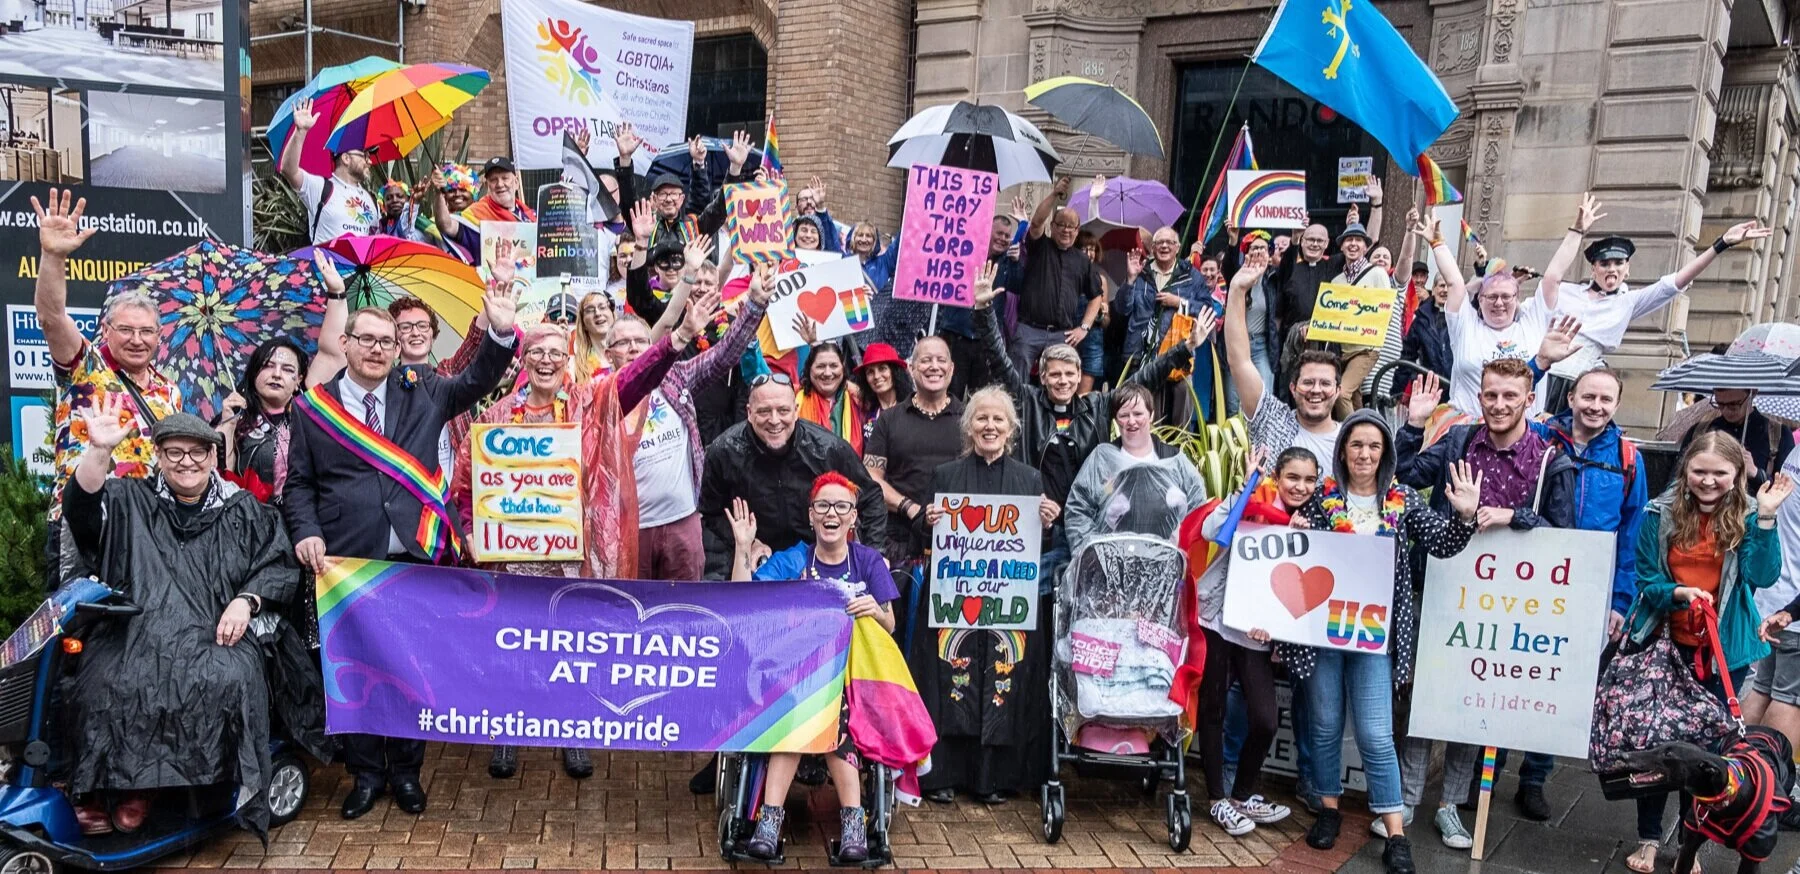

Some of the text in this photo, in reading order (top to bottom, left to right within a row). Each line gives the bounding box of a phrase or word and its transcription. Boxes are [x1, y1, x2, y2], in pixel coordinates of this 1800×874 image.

[622, 31, 636, 41] Safe
[638, 36, 657, 45] sacred
[616, 49, 674, 71] LGBTQIA+
[616, 70, 669, 94] Christians
[1193, 97, 1338, 131] RANDO
[590, 118, 616, 139] TAB
[912, 165, 992, 195] THIS IS
[924, 191, 982, 217] A GAY
[1255, 205, 1304, 220] KINDNESS
[739, 220, 784, 244] WINS
[929, 213, 967, 235] THE
[537, 245, 597, 259] Rainbow
[922, 233, 974, 257] LORD
[18, 255, 40, 279] AL
[926, 258, 965, 280] HAS
[913, 278, 968, 301] MADE
[838, 287, 869, 331] U
[1319, 290, 1349, 310] Come
[1353, 302, 1379, 316] you
[1360, 327, 1378, 336] you
[14, 350, 52, 367] 015
[484, 428, 554, 457] Come
[658, 427, 681, 444] TABLE
[480, 470, 575, 493] as you are
[500, 497, 562, 514] thats how
[483, 521, 578, 556] I love you
[936, 533, 1026, 561] uniqueness
[1237, 531, 1310, 561] GOD
[937, 555, 1038, 580] FILLS A NEED
[1474, 553, 1572, 586] God
[956, 575, 1009, 595] in our
[1458, 586, 1567, 616] loves
[1326, 599, 1387, 650] US
[495, 627, 721, 657] CHRISTIANS
[1071, 640, 1119, 655] OLICE
[1445, 620, 1569, 656] All her
[548, 661, 718, 688] AT PRIDE
[1072, 654, 1115, 671] RIDE
[1470, 657, 1562, 682] Queer
[1463, 692, 1558, 715] children
[418, 707, 680, 746] #christiansatpride
